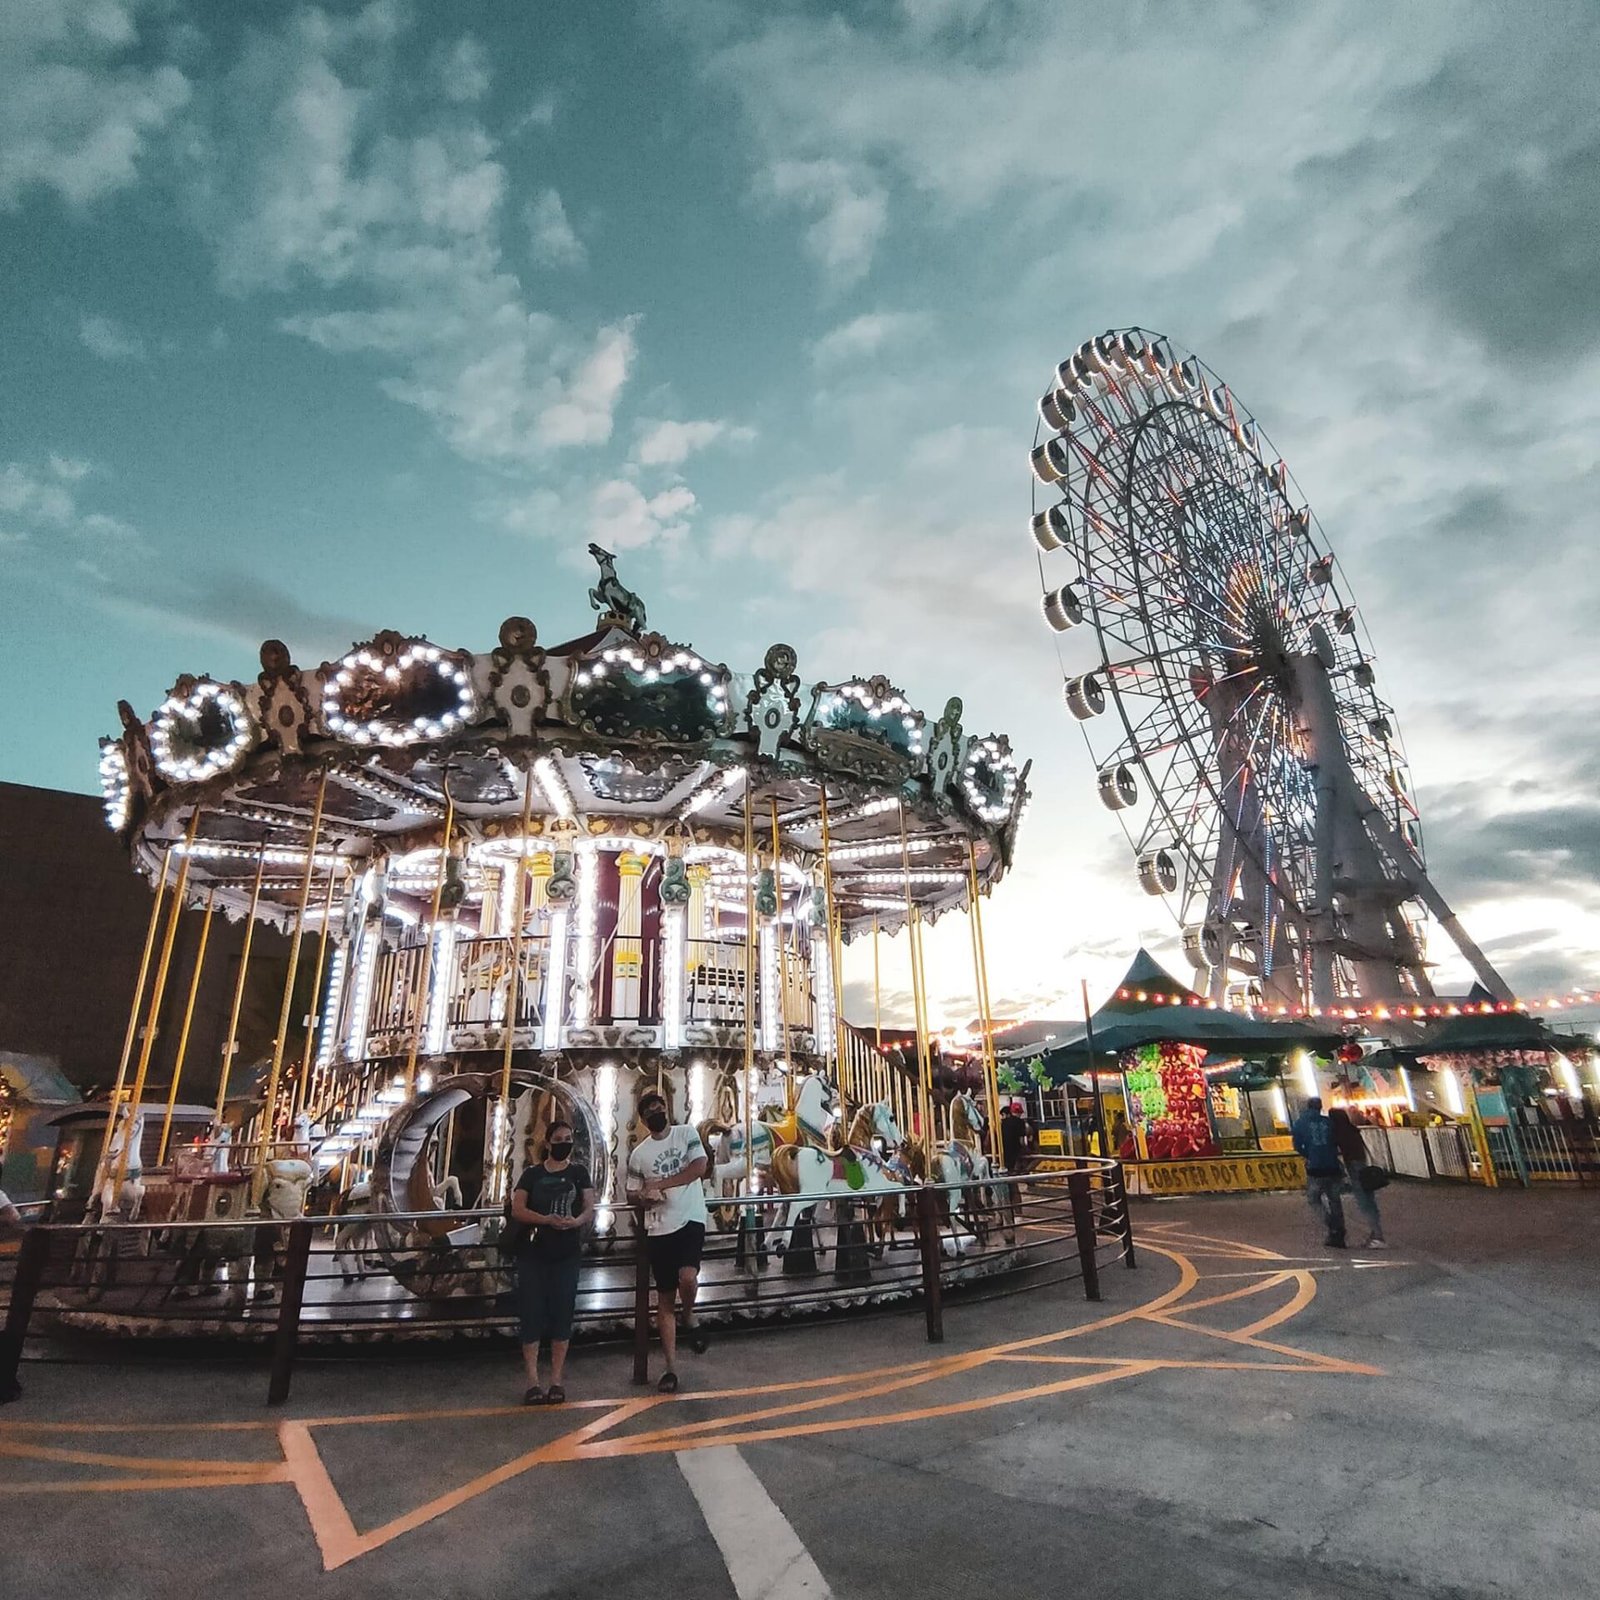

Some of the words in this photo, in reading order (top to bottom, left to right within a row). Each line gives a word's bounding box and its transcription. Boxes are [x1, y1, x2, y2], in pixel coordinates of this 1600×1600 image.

[1143, 1166, 1209, 1189] LOBSTER
[1210, 1164, 1238, 1184] POT
[1257, 1161, 1299, 1182] STICK
